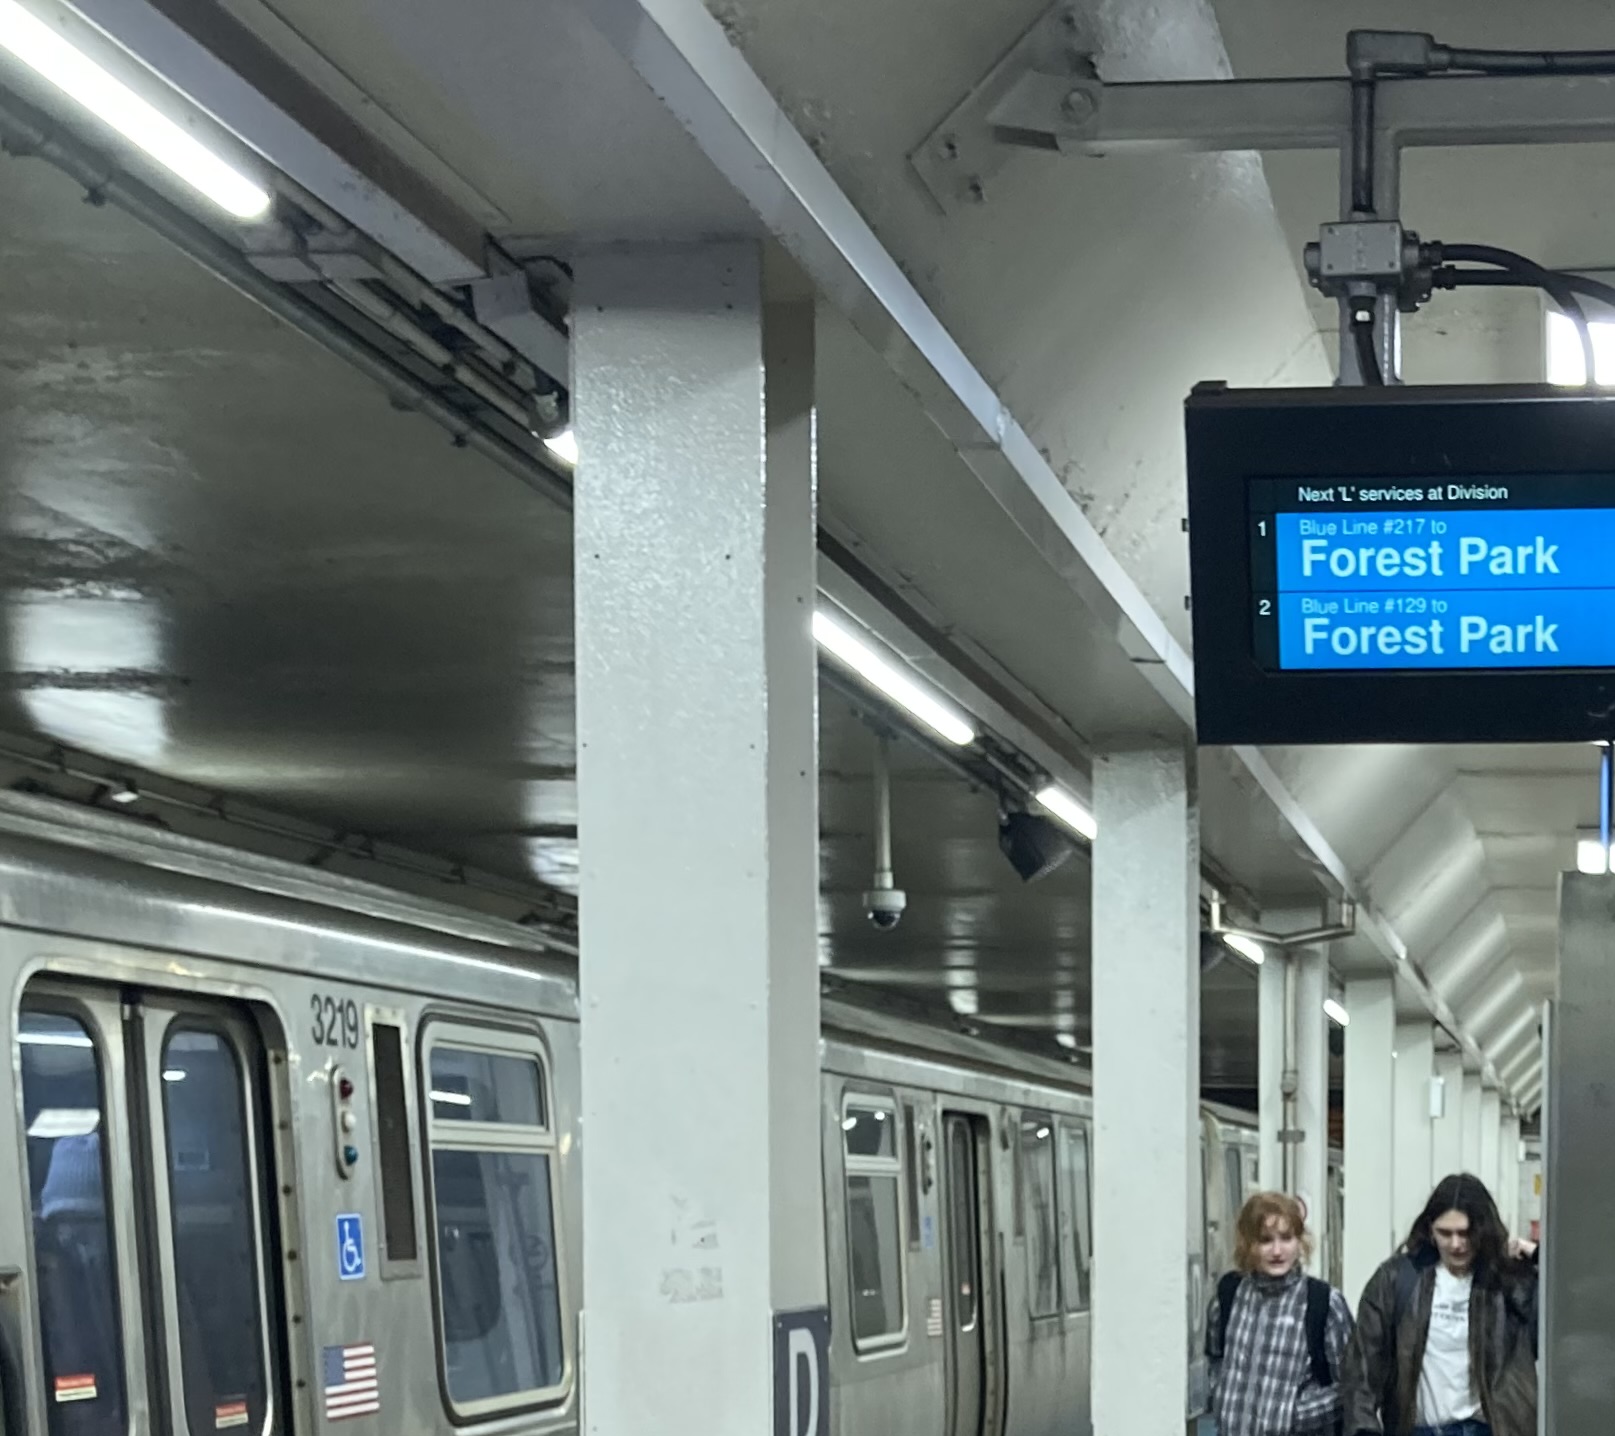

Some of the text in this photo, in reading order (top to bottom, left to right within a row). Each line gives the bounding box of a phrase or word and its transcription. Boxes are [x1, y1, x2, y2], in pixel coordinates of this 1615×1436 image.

[1298, 485, 1508, 501] Next 'L' services at Division
[1258, 521, 1266, 536] 1
[1300, 518, 1447, 535] Blue Line #217 to
[1302, 536, 1560, 577] Forest Park
[1259, 599, 1271, 615] 2
[1302, 598, 1448, 614] Blue Line #129 to
[1304, 615, 1559, 655] Forest Park
[310, 993, 359, 1050] 3219
